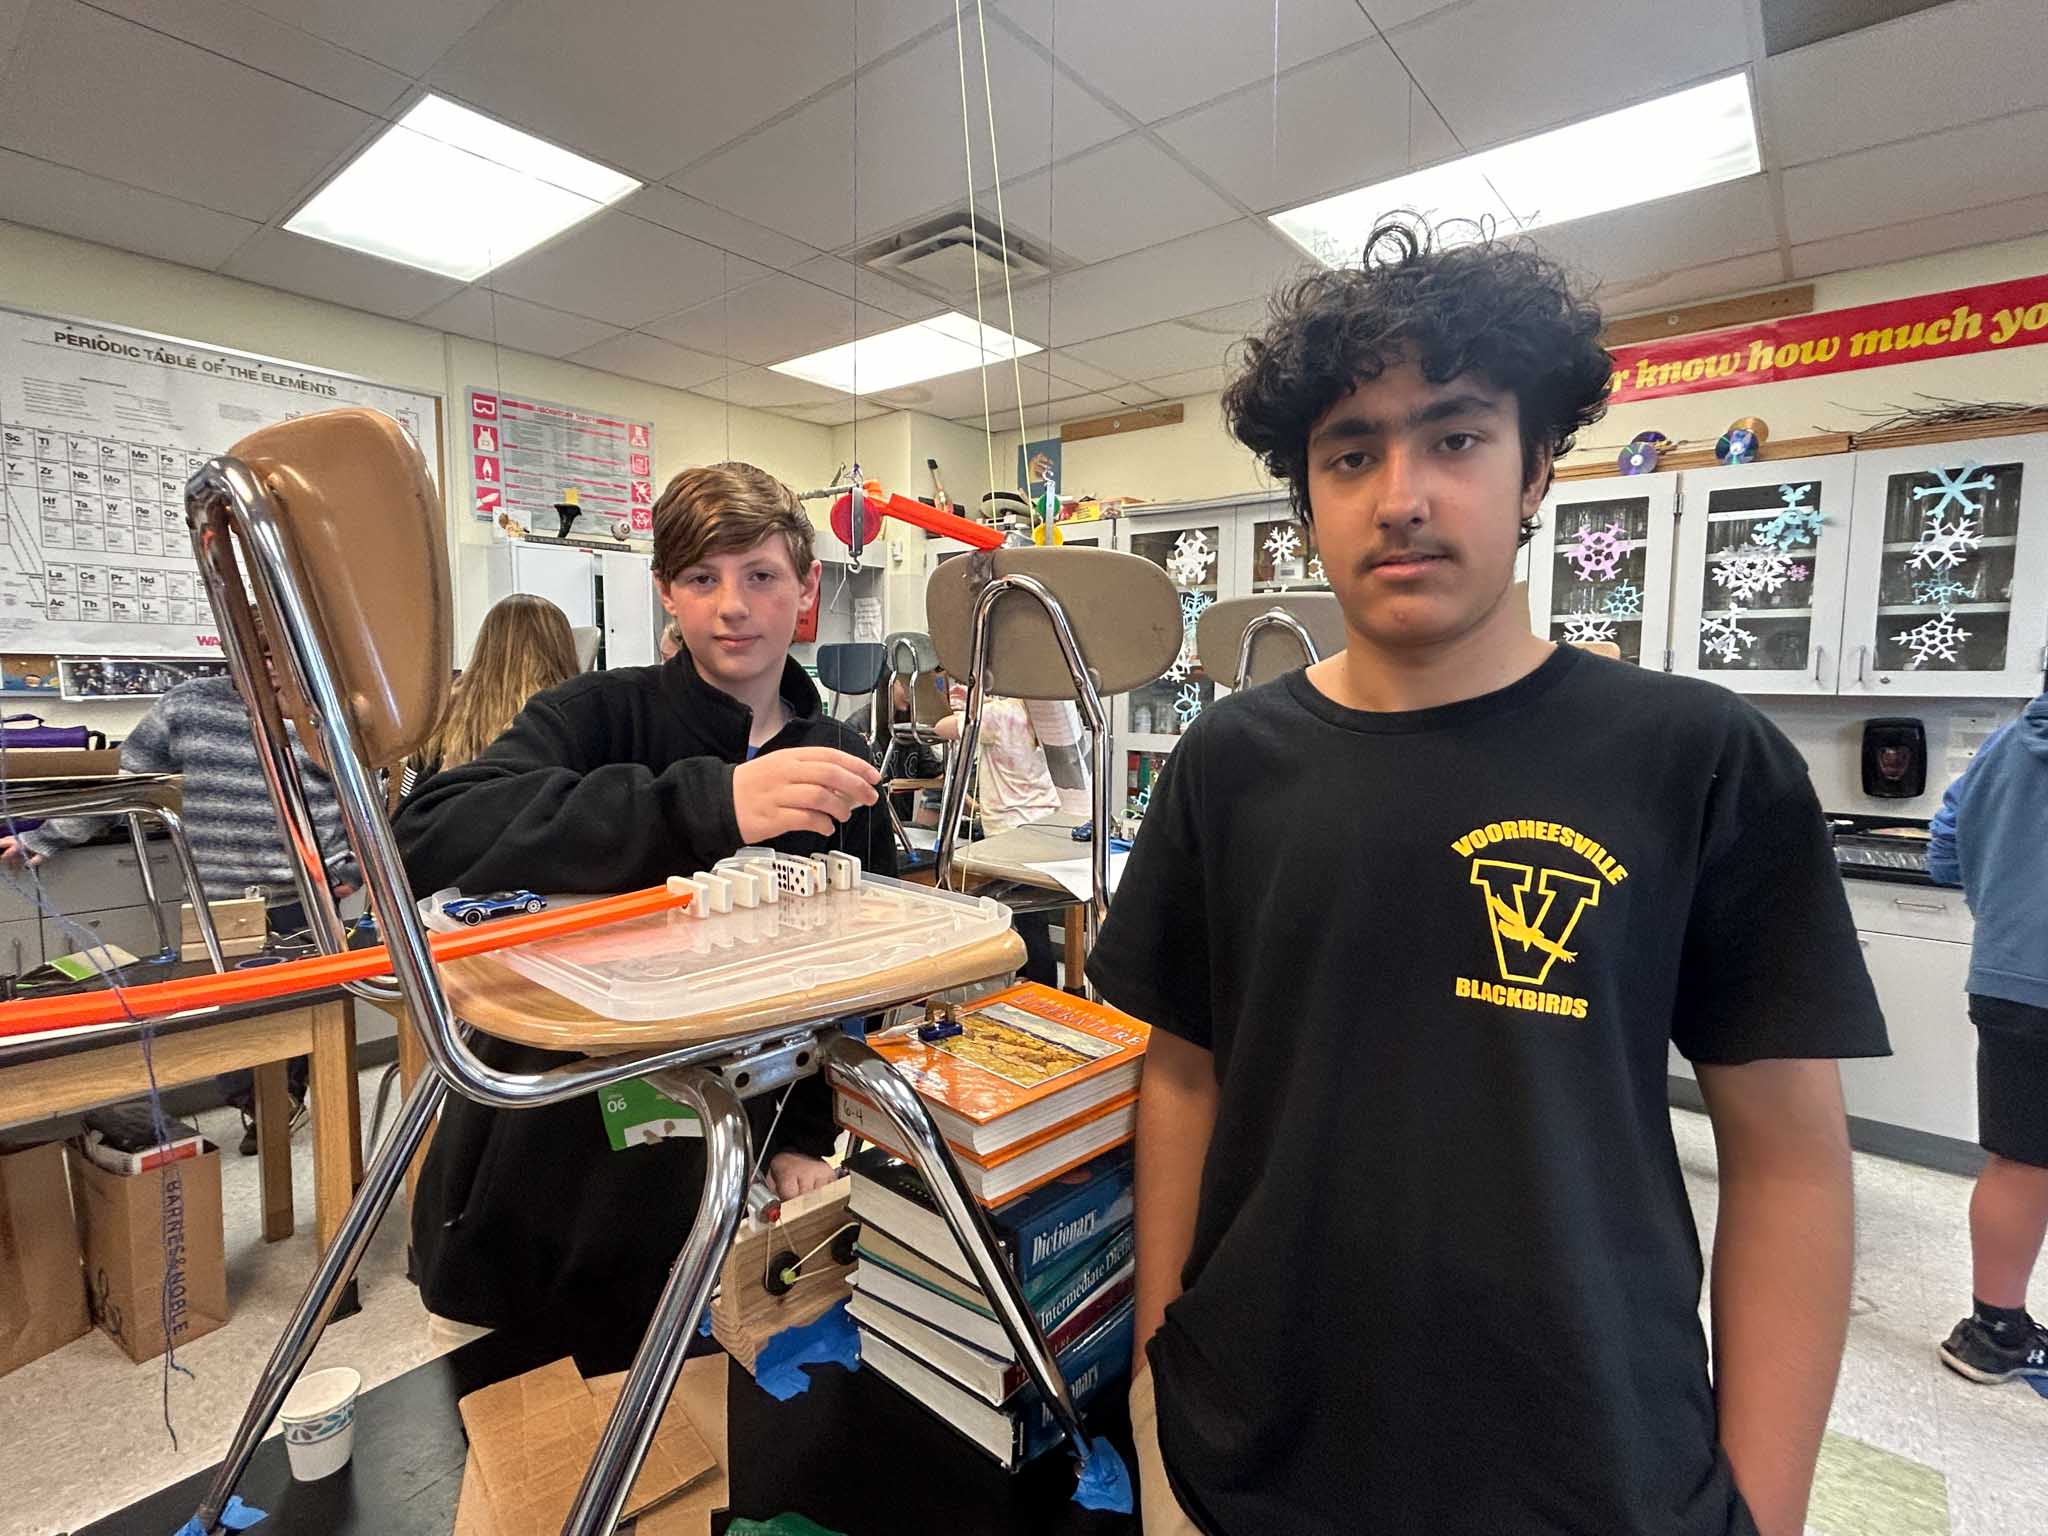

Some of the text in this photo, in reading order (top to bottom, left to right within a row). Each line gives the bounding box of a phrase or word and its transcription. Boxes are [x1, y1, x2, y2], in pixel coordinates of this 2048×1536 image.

[54, 331, 337, 396] PERIODIC TABLE OF THE ELEMENTS
[1604, 368, 1630, 393] r
[1635, 351, 1741, 389] know
[1746, 336, 1840, 372] how
[1850, 306, 1983, 357] much
[5, 432, 21, 442] Sc
[70, 441, 79, 449] V
[101, 446, 115, 454] Cr
[131, 450, 149, 459] Mn
[188, 458, 203, 467] Co
[7, 462, 16, 471] Y
[40, 466, 53, 475] Zr
[72, 470, 88, 480] Nb
[103, 474, 120, 484] Mo
[74, 499, 88, 508] Ta
[106, 503, 118, 511] W
[164, 509, 178, 518] Os
[48, 569, 63, 578] La
[80, 571, 96, 580] Ce
[111, 573, 123, 581] Pr
[140, 575, 155, 584] Nd
[50, 598, 65, 607] Ac
[82, 600, 97, 608] Th
[142, 602, 150, 610] U
[196, 635, 223, 646] WA
[1451, 820, 1629, 886] VOORHEESVILLE
[1455, 976, 1589, 1019] BLACKBIRDS
[1031, 1208, 1098, 1265] Dictionary
[168, 1270, 190, 1337] NOBLE
[1041, 1261, 1105, 1329] Intermediate
